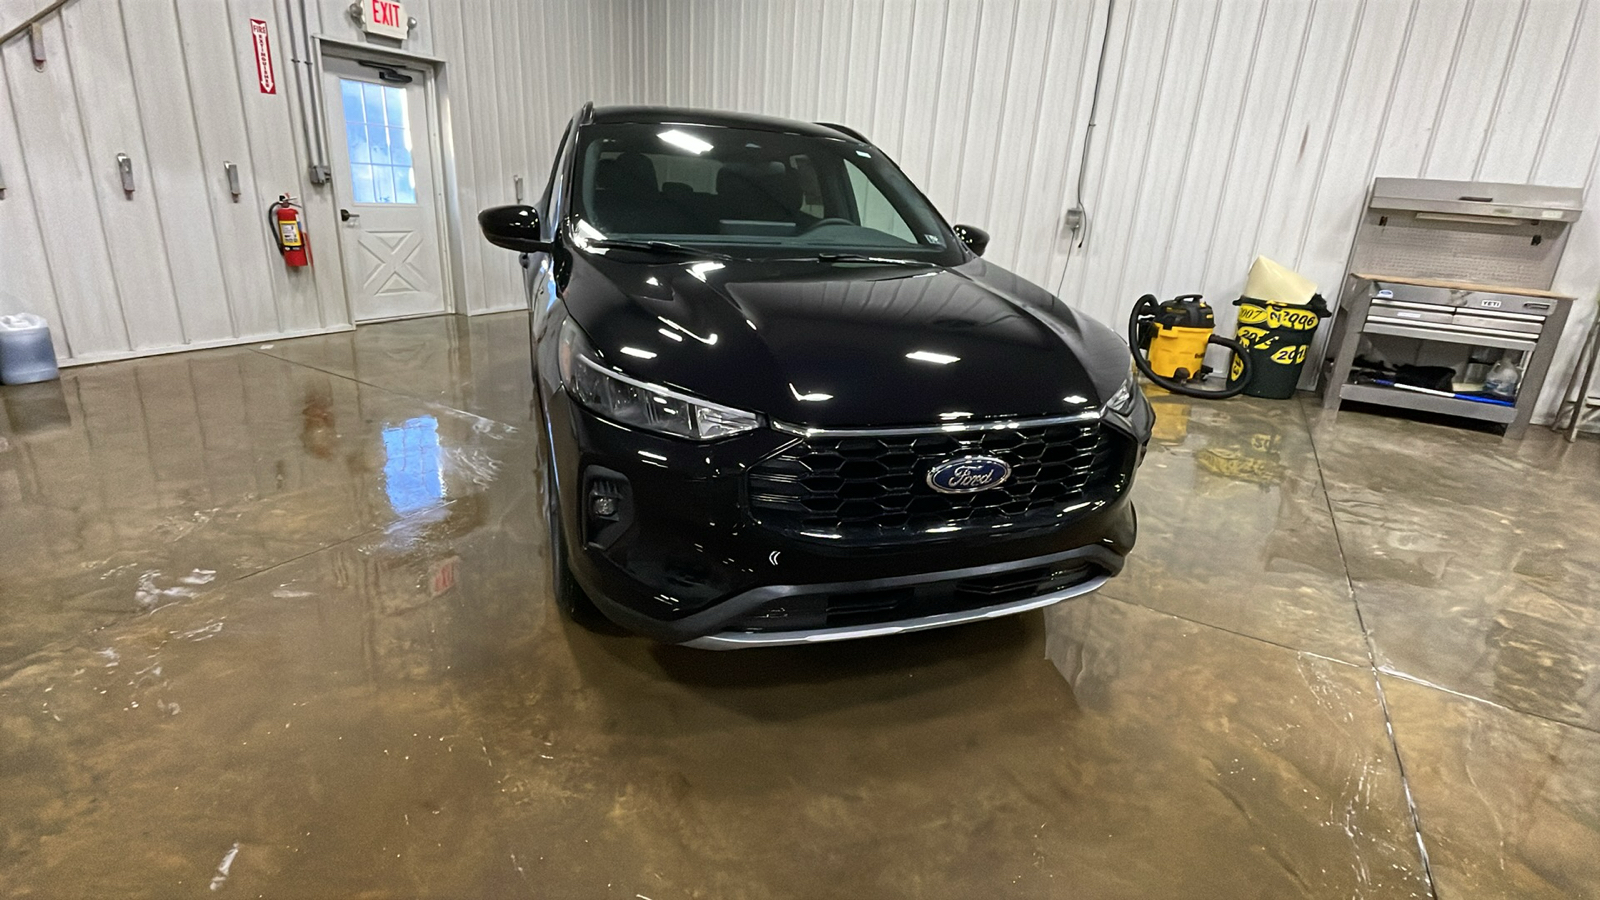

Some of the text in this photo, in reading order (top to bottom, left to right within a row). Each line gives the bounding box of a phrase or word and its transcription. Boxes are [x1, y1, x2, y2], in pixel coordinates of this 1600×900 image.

[372, 0, 400, 28] EXIT
[253, 24, 266, 34] FIRE
[1276, 349, 1306, 360] 201
[948, 465, 994, 487] Ford
